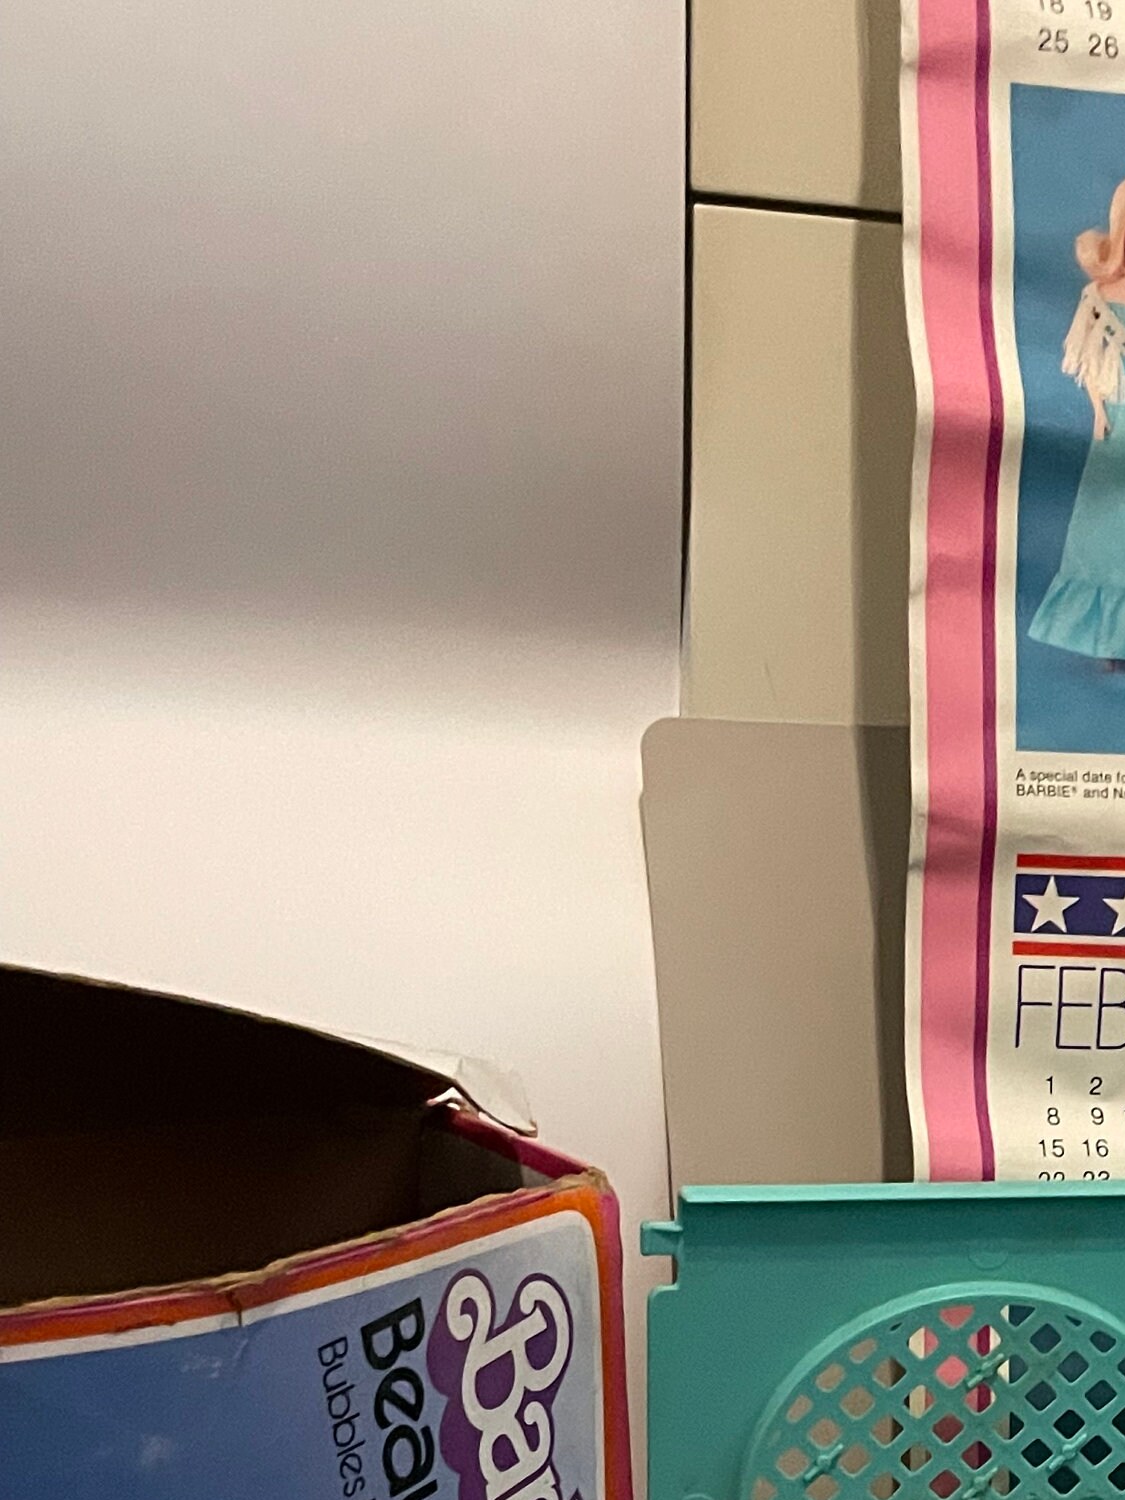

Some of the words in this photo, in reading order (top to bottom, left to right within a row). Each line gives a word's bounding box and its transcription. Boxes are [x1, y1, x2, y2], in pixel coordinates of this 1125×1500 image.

[1038, 28, 1069, 54] 25
[1088, 33, 1119, 59] 26
[1016, 769, 1025, 780] A
[1030, 771, 1078, 783] special
[1082, 772, 1111, 784] date
[1084, 788, 1108, 798] and
[1046, 1075, 1054, 1095] 1
[1088, 1076, 1103, 1096] 2
[1047, 1107, 1061, 1126] 8
[1090, 1106, 1105, 1126] 9
[317, 1337, 366, 1497] Bubbles
